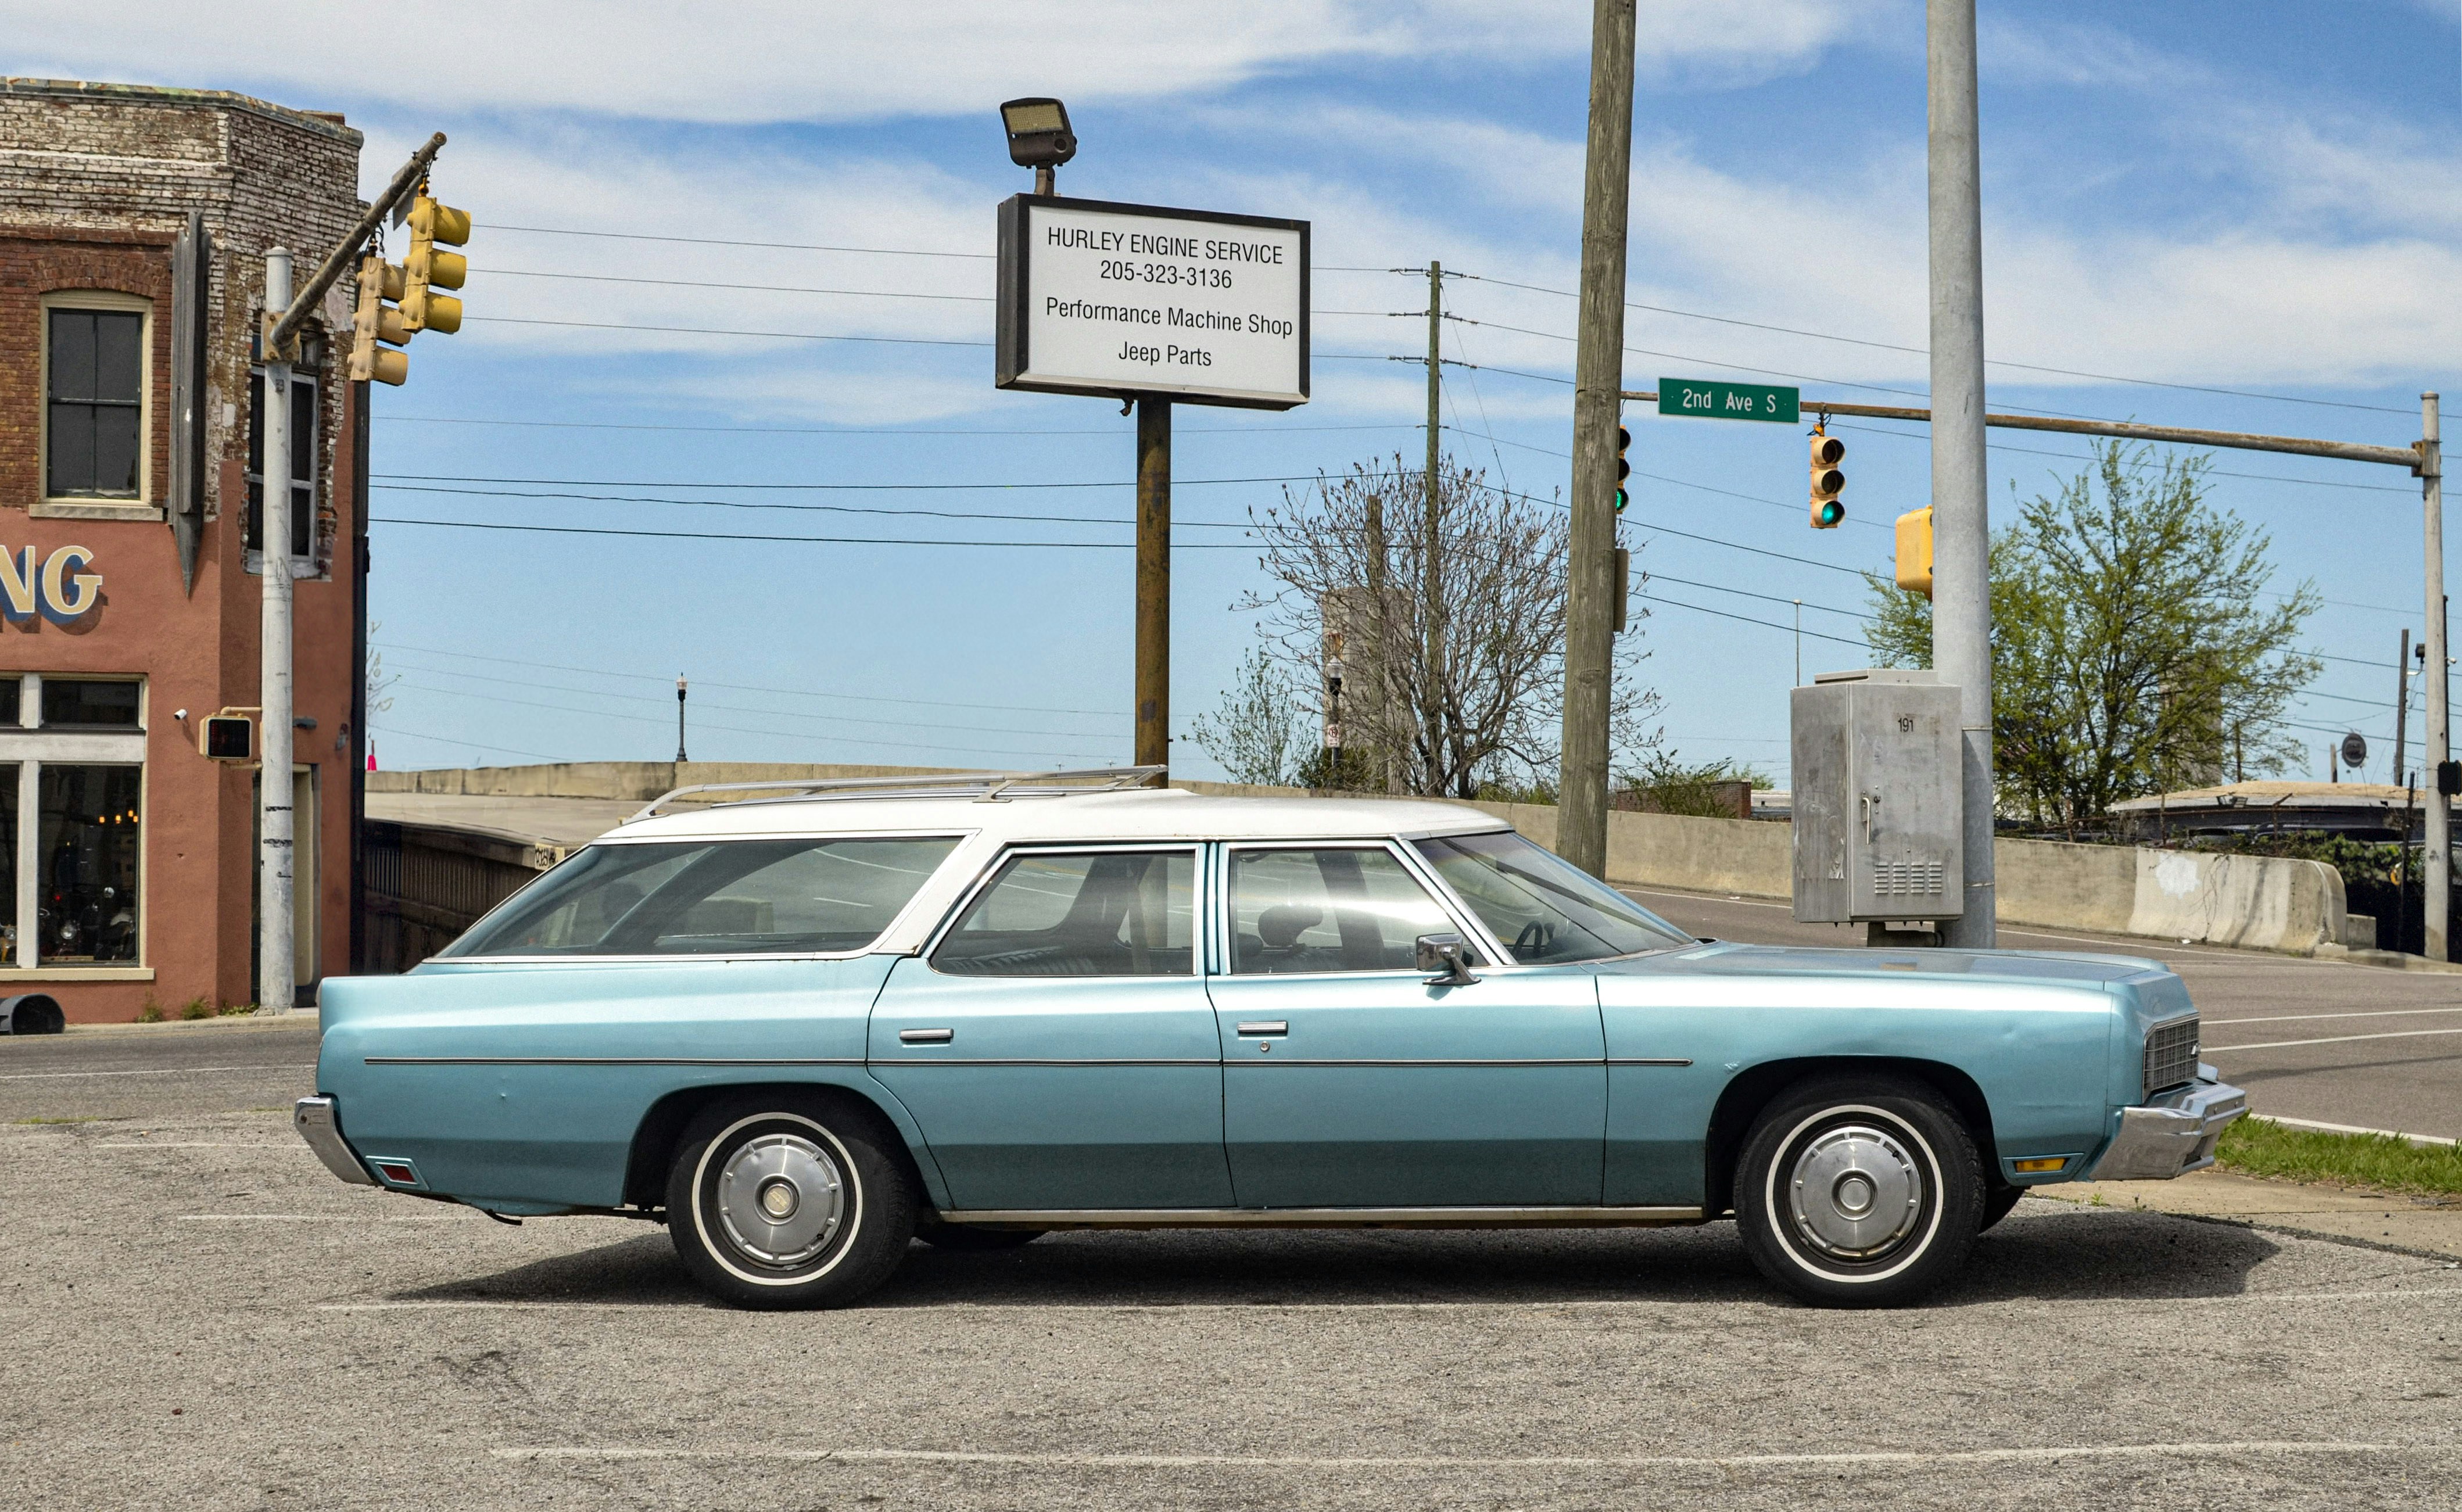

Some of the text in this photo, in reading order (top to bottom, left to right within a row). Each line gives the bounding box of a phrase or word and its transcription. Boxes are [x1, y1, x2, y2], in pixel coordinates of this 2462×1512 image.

[1048, 227, 1282, 264] HURLEY ENGINE SERVICE
[1101, 260, 1232, 289] 205-323-3136
[1047, 296, 1292, 339] Performance Machine Shop
[1119, 341, 1212, 367] Jeep Parts
[1683, 388, 1776, 413] 2nd Ave S
[0, 544, 103, 615] NG
[1897, 717, 1914, 733] 191
